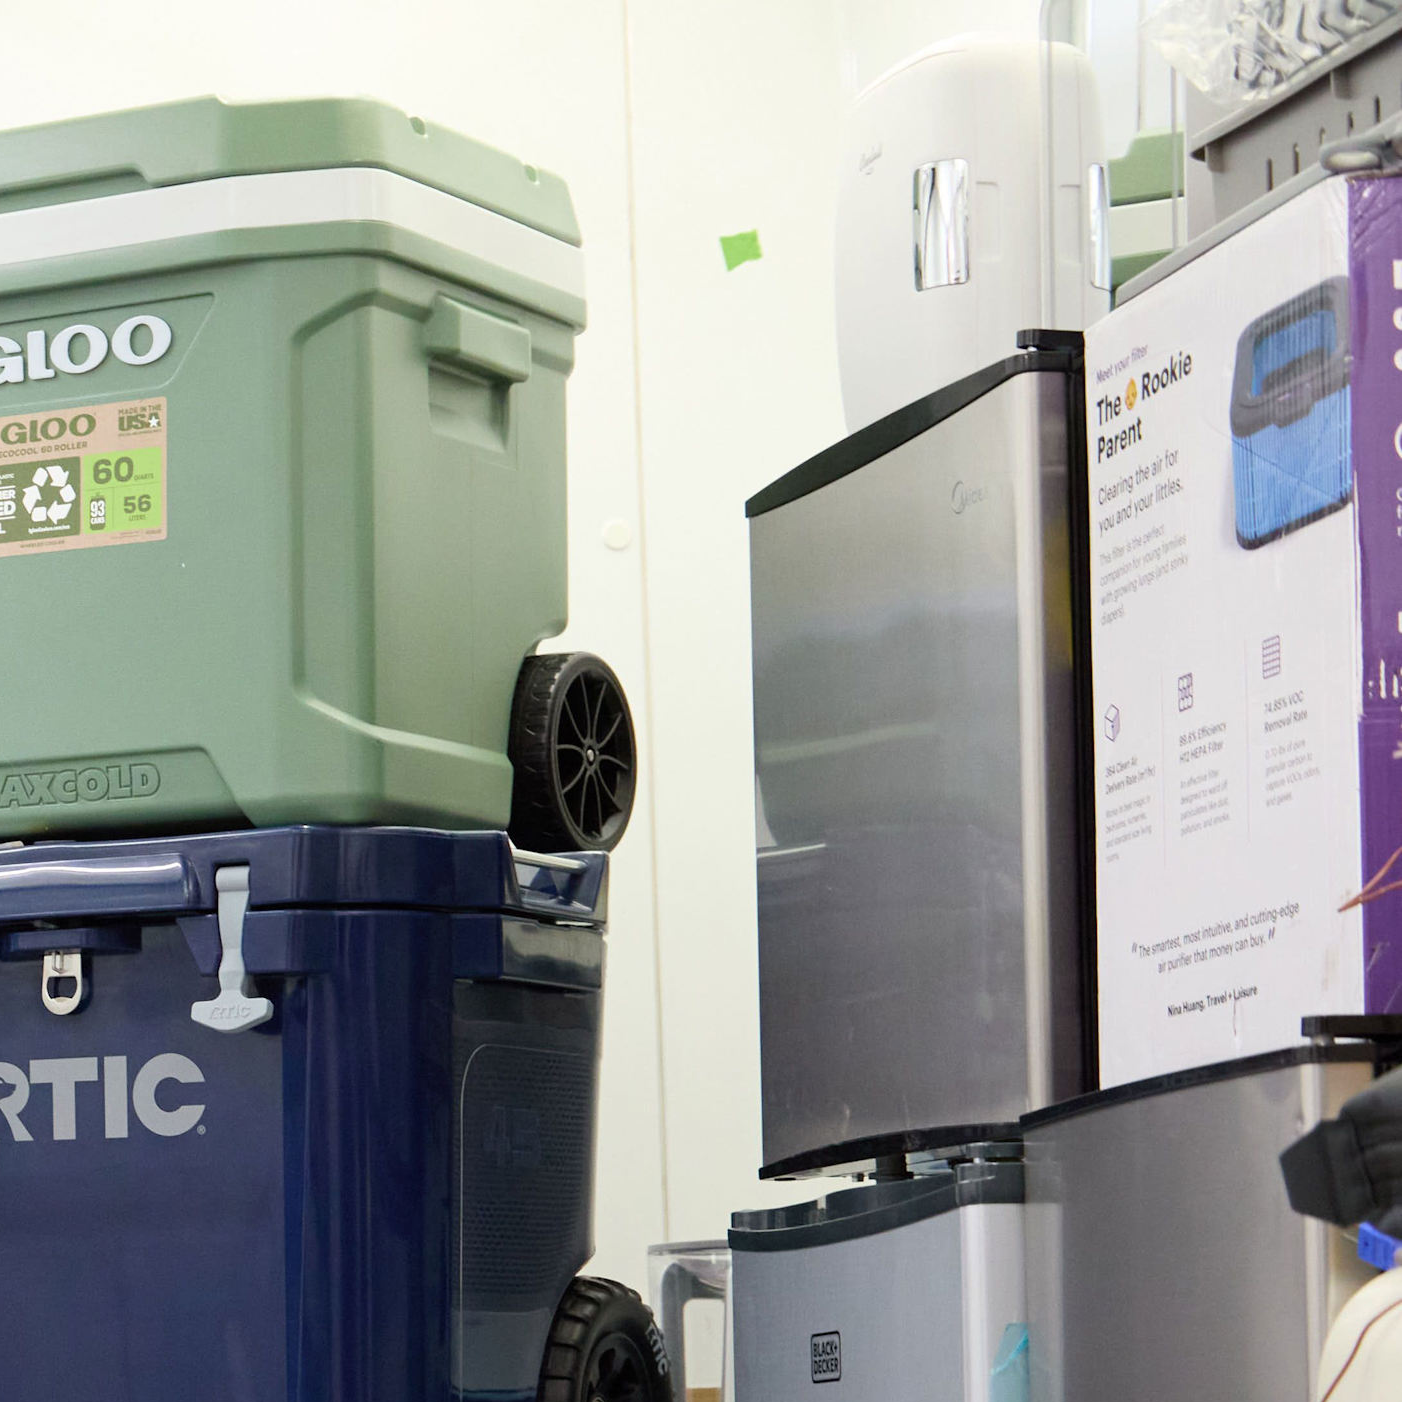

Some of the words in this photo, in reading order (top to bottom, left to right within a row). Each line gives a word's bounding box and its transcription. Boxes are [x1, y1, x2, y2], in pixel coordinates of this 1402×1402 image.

[1097, 394, 1121, 426] The
[1141, 350, 1192, 400] Rookie
[41, 446, 53, 454] 60
[54, 440, 88, 453] ROLLER
[1097, 417, 1142, 464] Parent
[93, 456, 134, 484] 60
[1098, 476, 1133, 505] Clearing
[1135, 463, 1150, 485] the
[1151, 456, 1163, 476] air
[1165, 449, 1179, 469] for
[90, 500, 105, 517] 93
[123, 494, 152, 514] 56
[1099, 514, 1115, 537] you
[1116, 500, 1132, 524] and
[1133, 492, 1153, 519] your
[1138, 944, 1151, 958] The
[1183, 930, 1201, 946] most
[1234, 913, 1249, 930] and
[1249, 901, 1299, 927] cutting-edge
[1157, 960, 1167, 974] air
[1168, 952, 1192, 973] purifier
[1193, 949, 1208, 964] that
[1209, 944, 1233, 964] money
[1234, 938, 1249, 953] can
[1206, 990, 1227, 1007] Travel
[813, 1340, 839, 1358] BLACK+
[813, 1357, 839, 1375] DECKER
